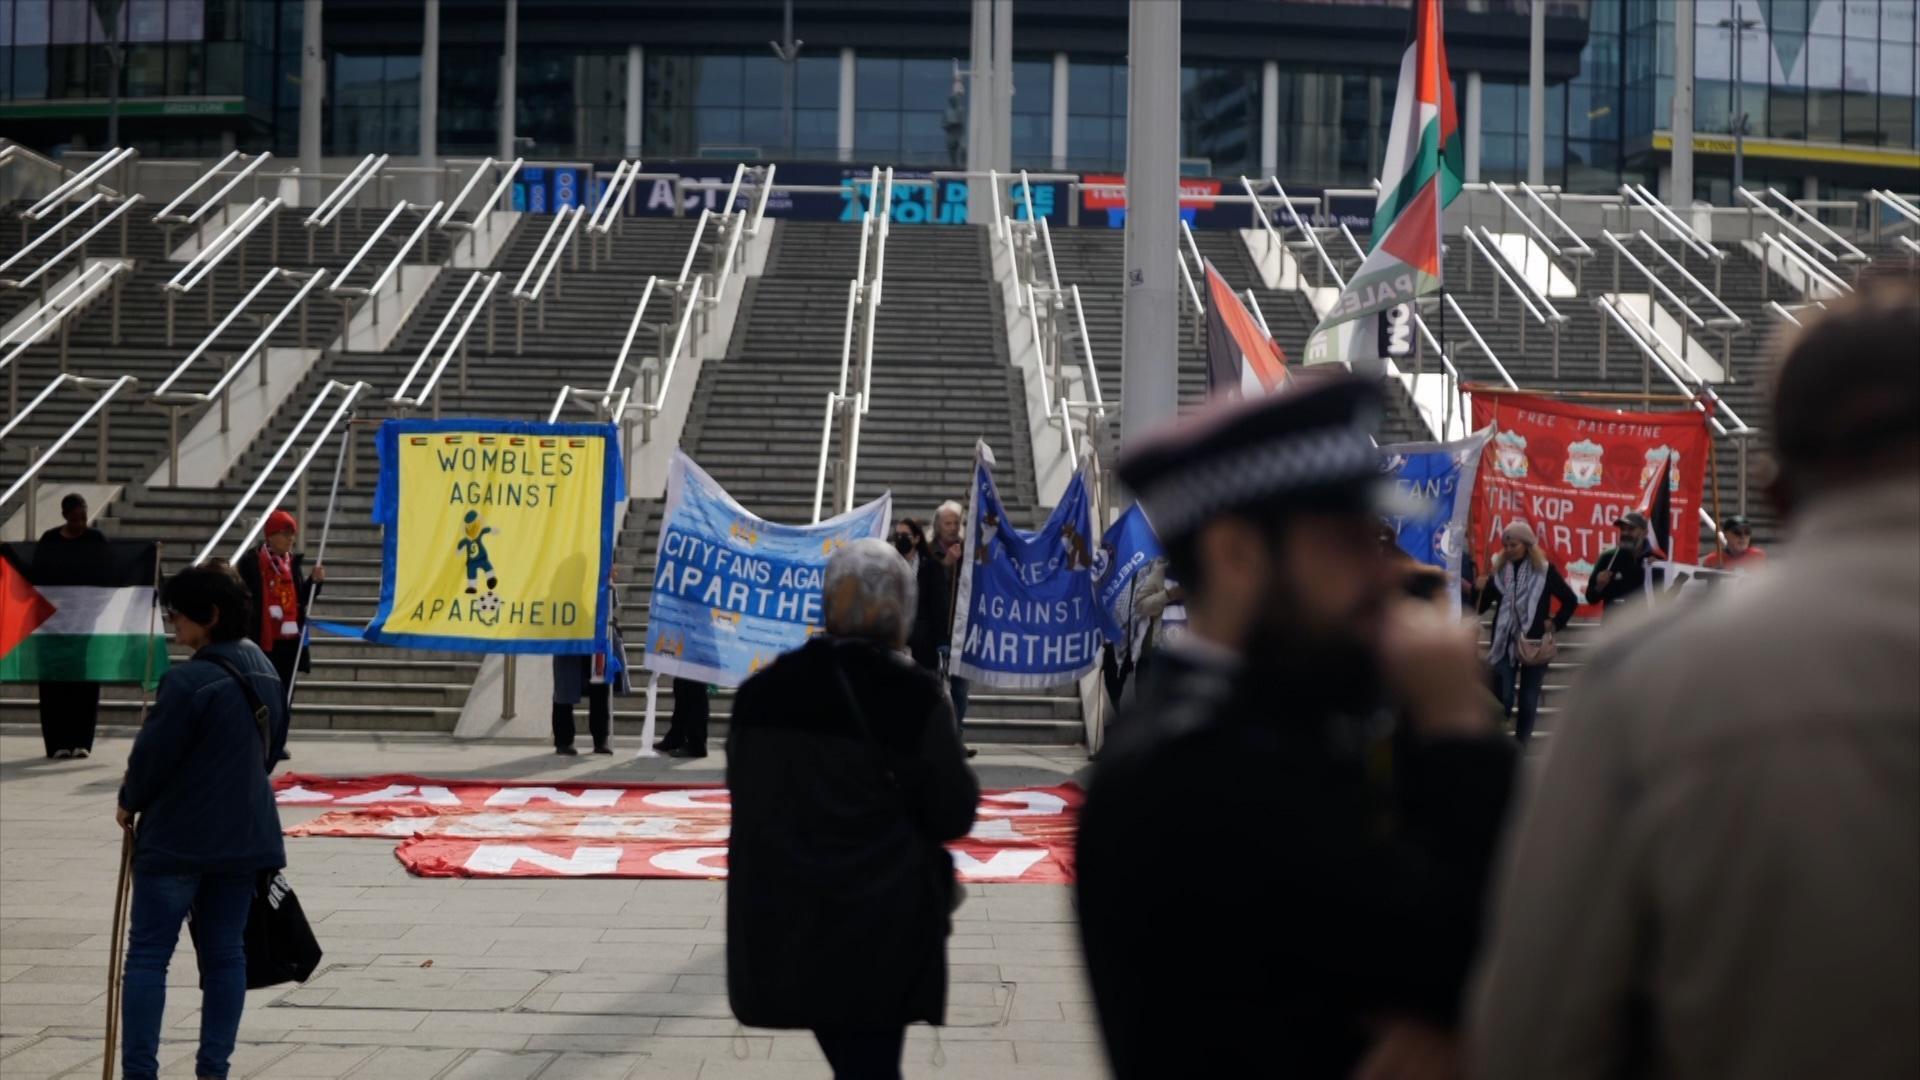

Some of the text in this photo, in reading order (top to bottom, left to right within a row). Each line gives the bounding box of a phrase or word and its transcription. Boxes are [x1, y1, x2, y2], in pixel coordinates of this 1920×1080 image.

[649, 177, 722, 209] ACT
[945, 181, 1056, 201] DCE
[1517, 410, 1663, 438] FREE PALESTINE
[437, 448, 574, 476] WOMBLES
[450, 481, 557, 508] AGAINST
[1486, 485, 1526, 513] THE
[1532, 495, 1574, 521] KOP
[1591, 503, 1683, 530] AGAT
[664, 531, 716, 566] CITY
[715, 550, 771, 584] FANS
[656, 561, 821, 624] APARTHE
[411, 599, 577, 626] APARTHEID
[977, 593, 1082, 623] AGAINST
[964, 624, 1102, 666] AARTHEID
